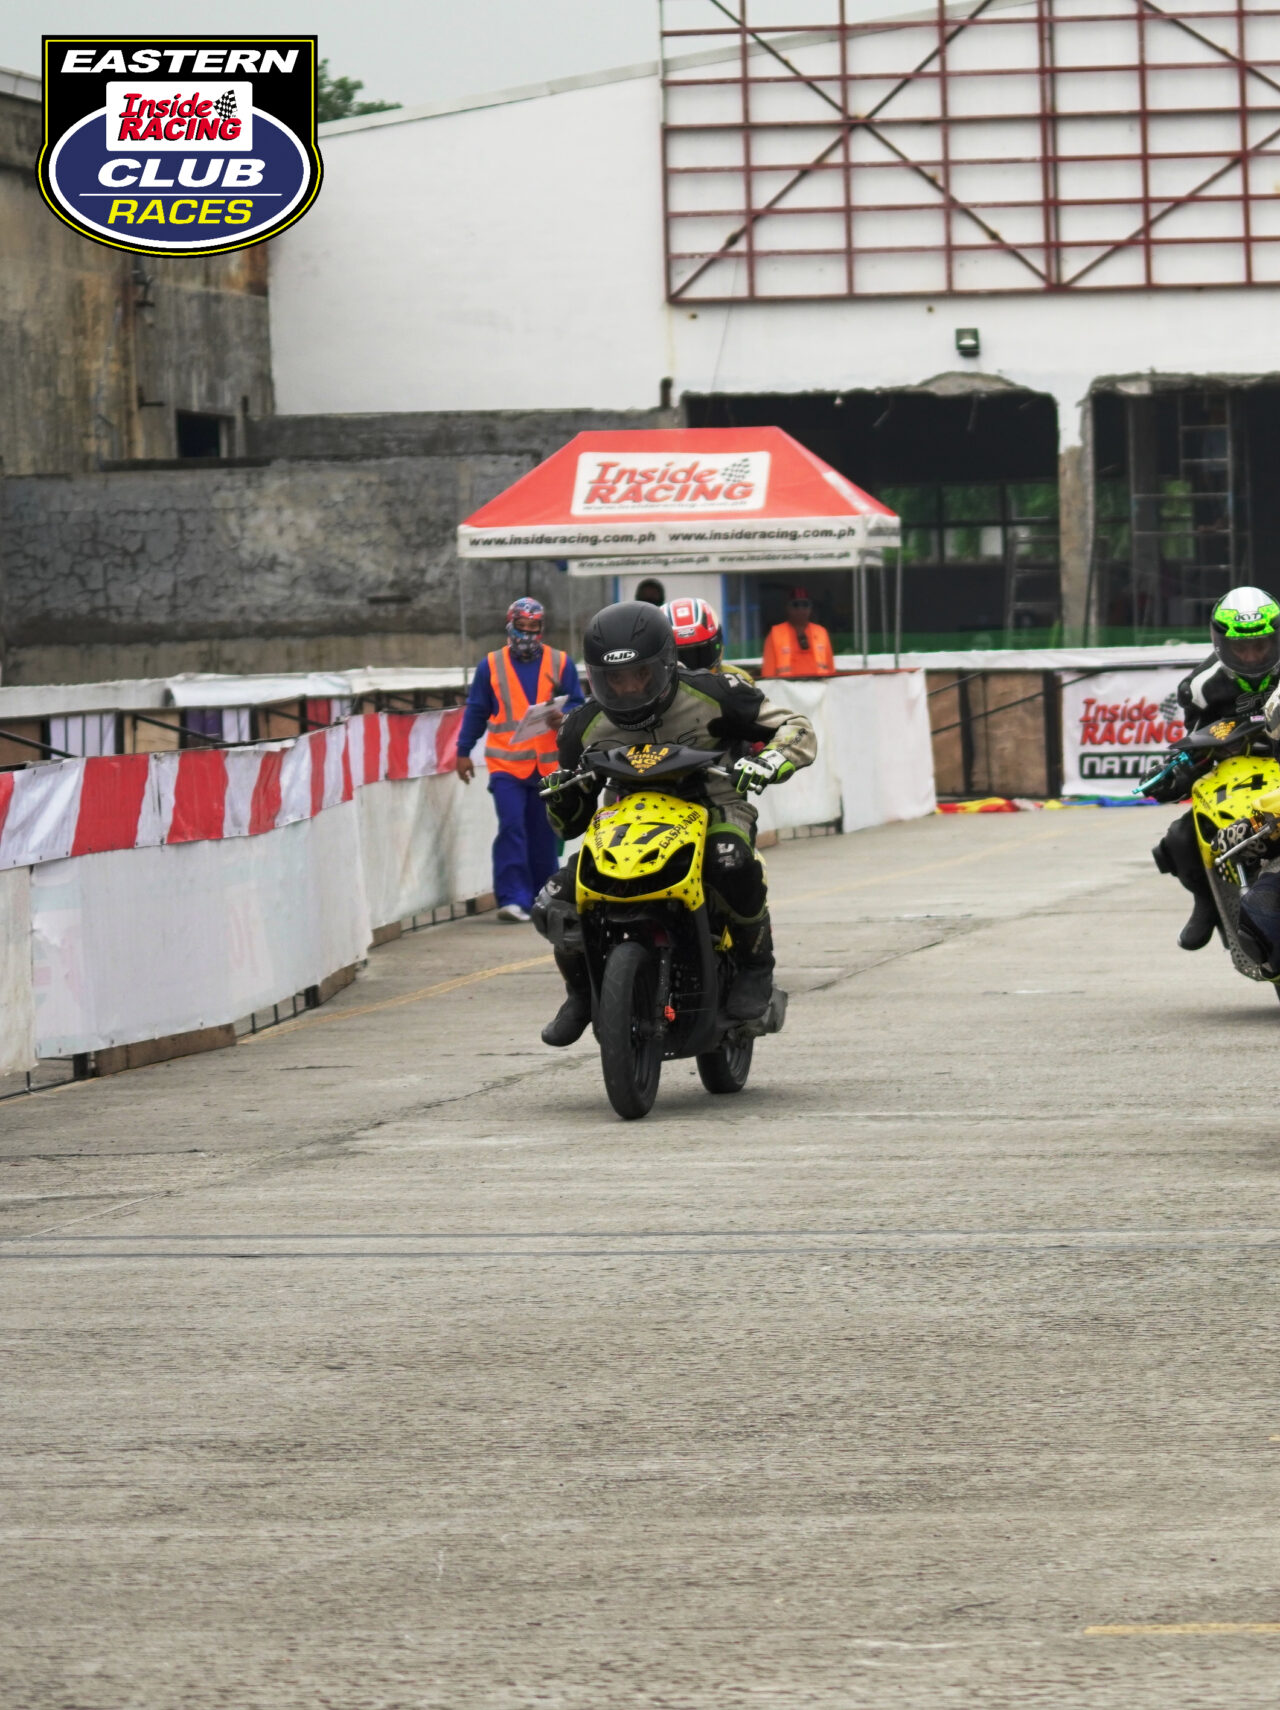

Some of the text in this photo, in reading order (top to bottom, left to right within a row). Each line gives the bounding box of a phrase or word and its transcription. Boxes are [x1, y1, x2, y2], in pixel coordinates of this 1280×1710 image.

[589, 461, 718, 485] Inside
[584, 482, 755, 504] RACING
[469, 527, 856, 546] www.insideracing.com.ph www.insideracing.com.ph
[606, 651, 633, 661] HJC
[1080, 697, 1160, 722] Inside
[1080, 720, 1184, 745] RACING
[1214, 773, 1268, 804] 14
[608, 822, 675, 848] 17
